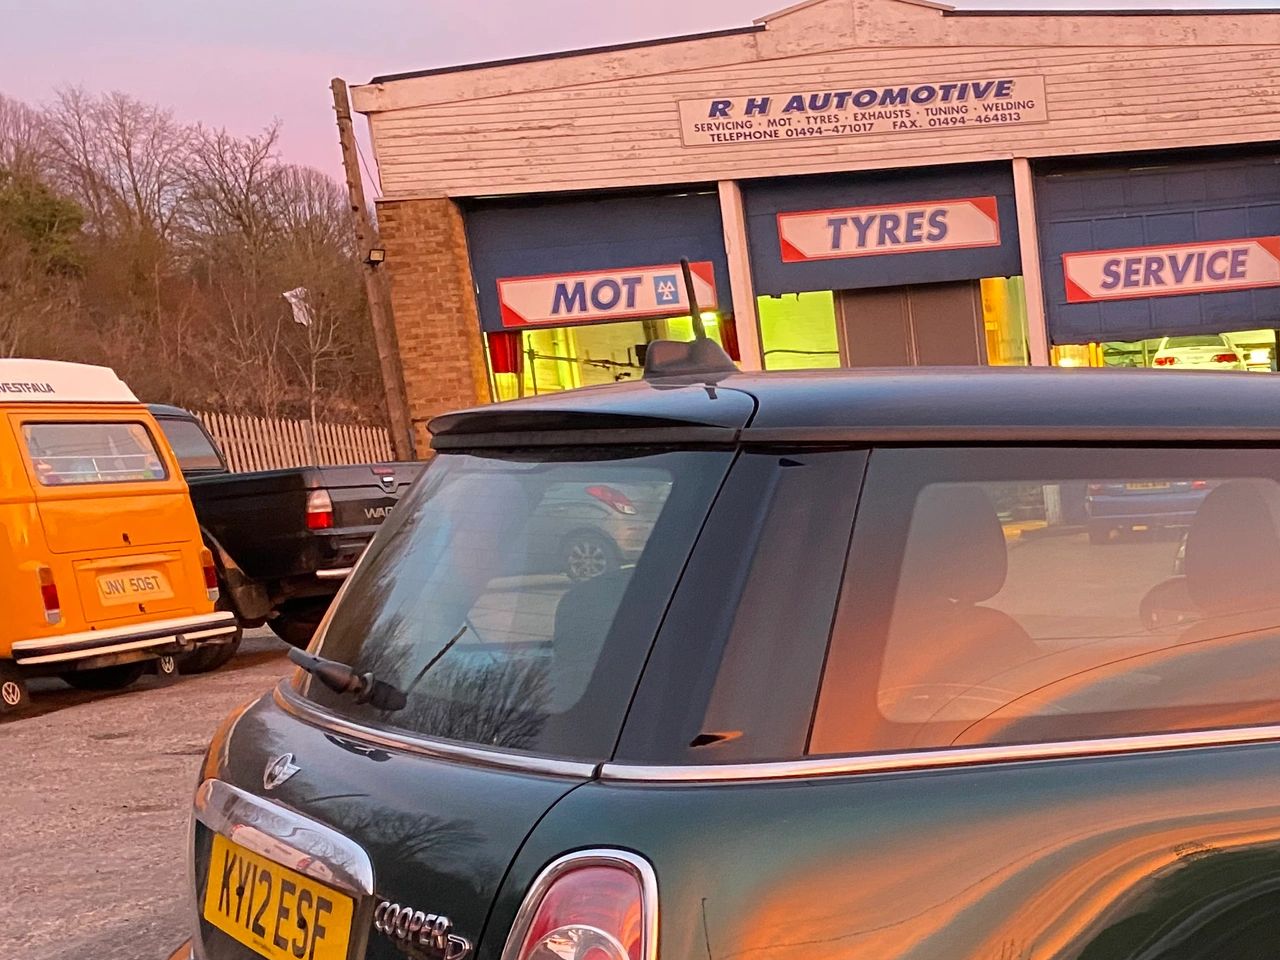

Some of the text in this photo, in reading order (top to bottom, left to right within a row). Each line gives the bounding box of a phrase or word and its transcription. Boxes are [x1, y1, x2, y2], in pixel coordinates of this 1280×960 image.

[694, 100, 1035, 132] SERVICING MOT TYRES EXHAUSTS TUNING WELDING
[708, 80, 1014, 118] R H AUTOMOTIVE
[709, 130, 780, 142] TELEPHONE
[785, 123, 874, 137] 01494-471017
[928, 112, 1021, 127] 01494-464813
[827, 209, 949, 250] TYRES
[1099, 248, 1249, 290] SERVICE
[550, 277, 643, 315] MOT
[105, 576, 160, 595] JNV 506T
[374, 901, 454, 949] COOPER
